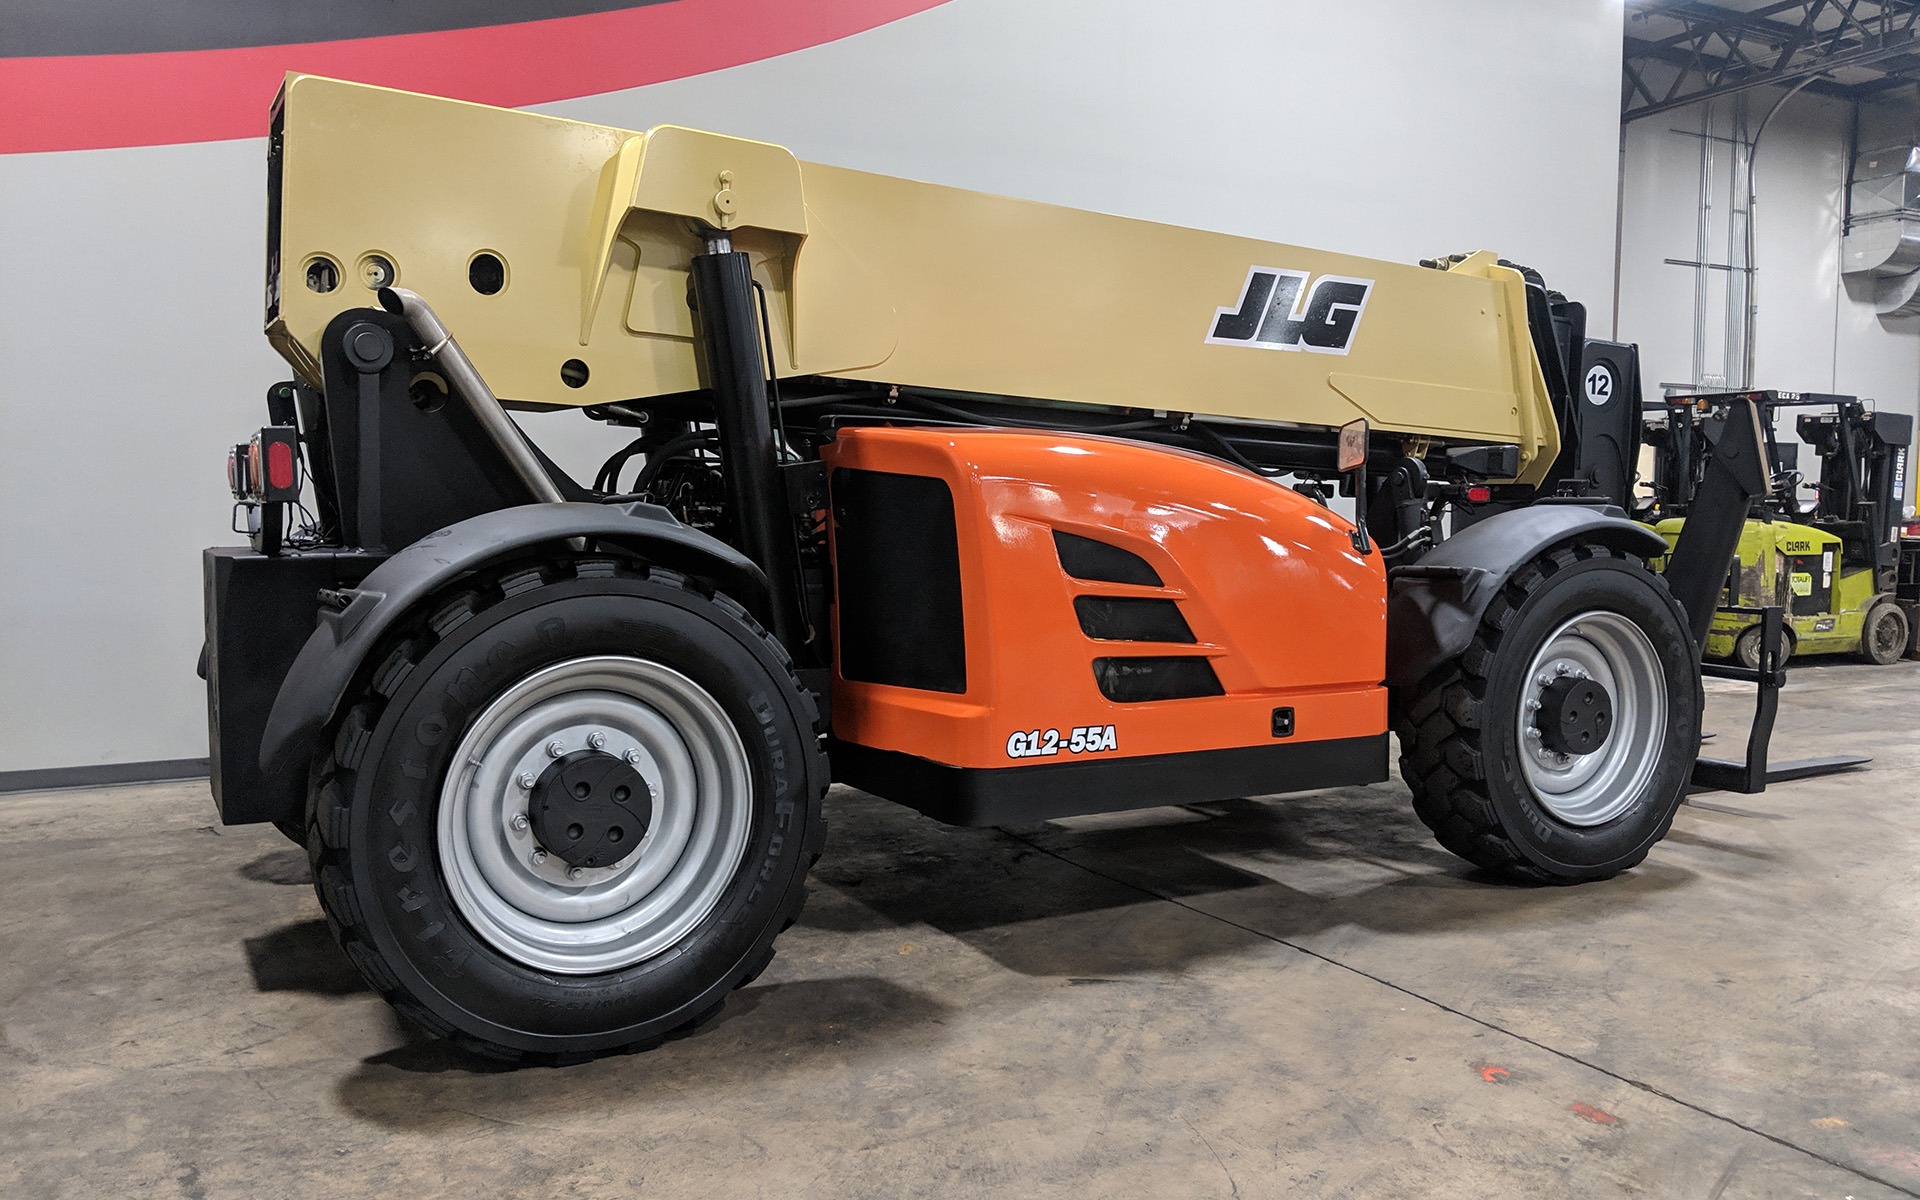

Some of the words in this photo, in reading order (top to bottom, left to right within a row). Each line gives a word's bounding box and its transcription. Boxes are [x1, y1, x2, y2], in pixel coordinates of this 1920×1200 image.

[1208, 268, 1372, 354] JLG
[1588, 373, 1609, 396] 12
[1895, 447, 1906, 482] CLARK
[1786, 541, 1811, 552] CLARK
[1006, 724, 1118, 758] G12-55A
